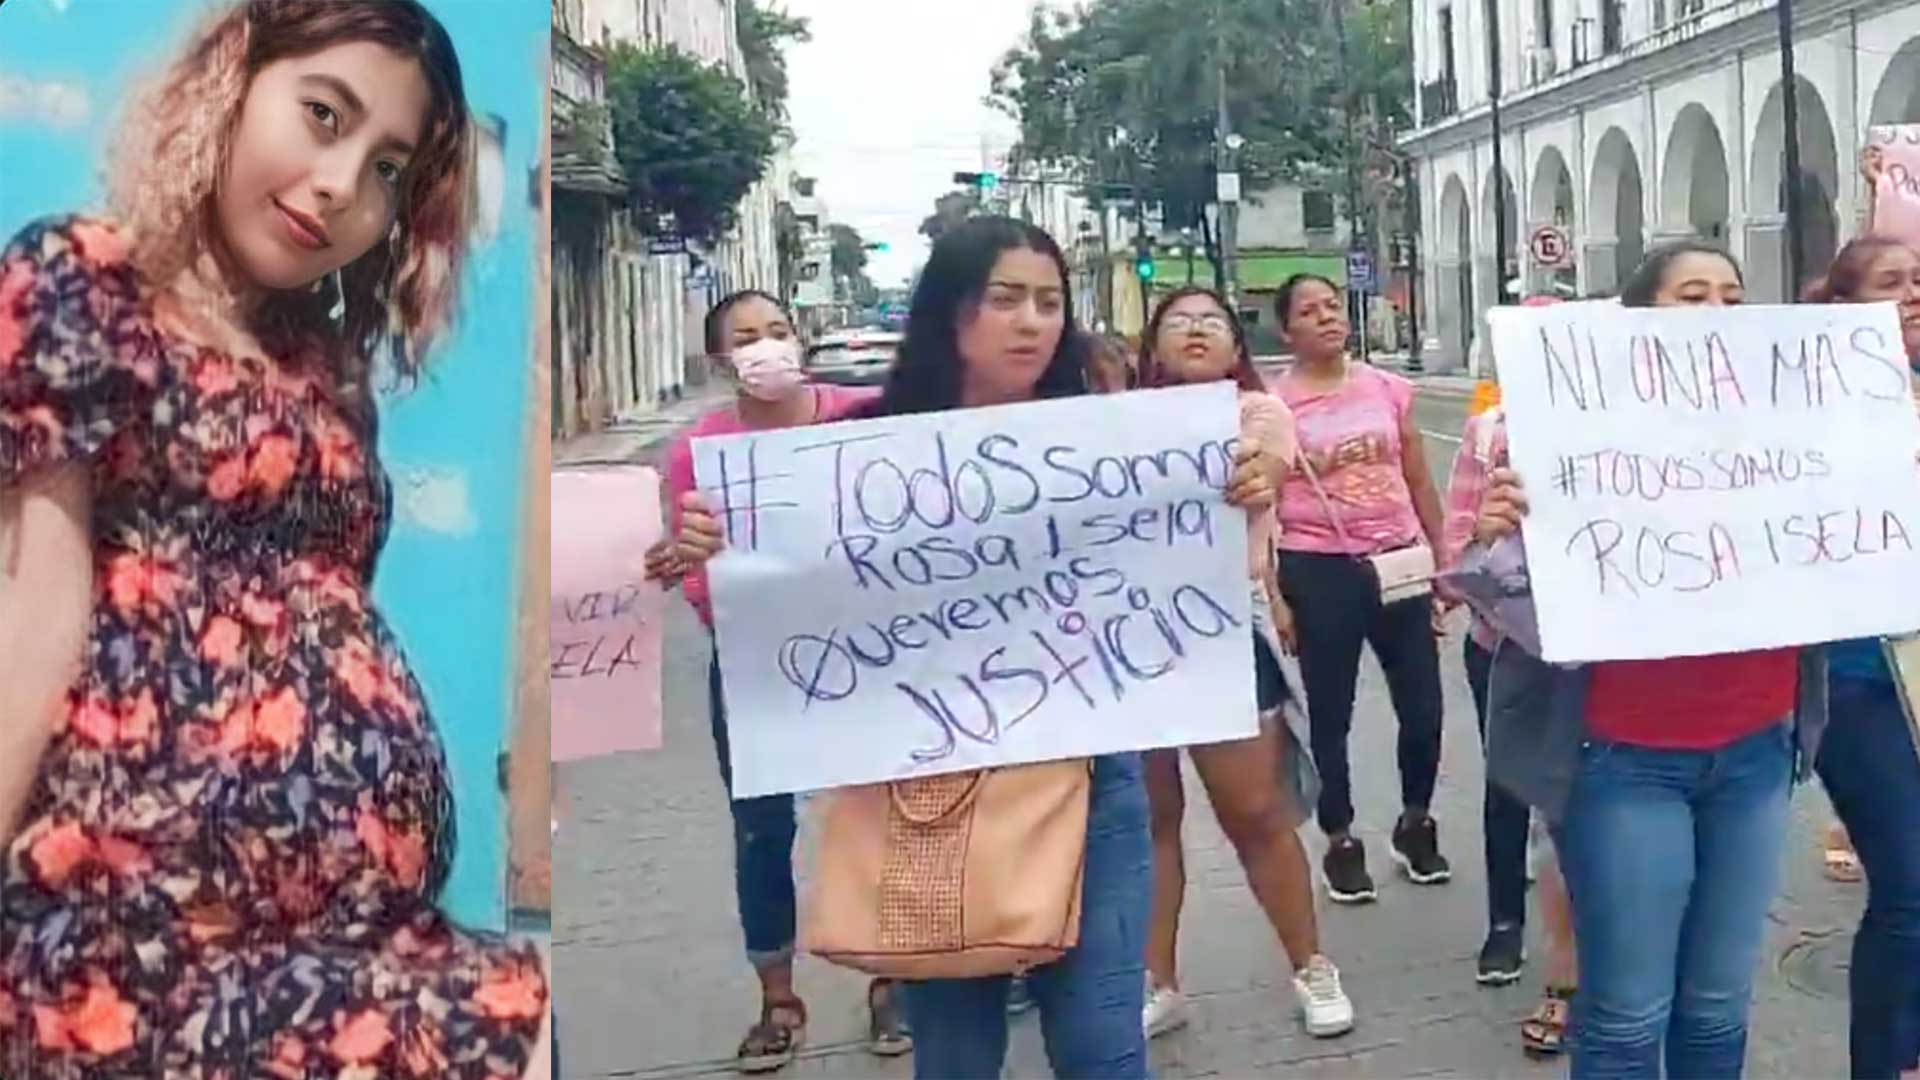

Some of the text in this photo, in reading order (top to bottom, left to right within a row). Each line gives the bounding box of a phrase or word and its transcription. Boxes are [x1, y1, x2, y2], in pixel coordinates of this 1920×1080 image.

[1538, 324, 1608, 411] NI
[1629, 330, 1747, 412] UNA
[826, 534, 1020, 590] Rosa
[1564, 505, 1913, 600] ROSA ISELA
